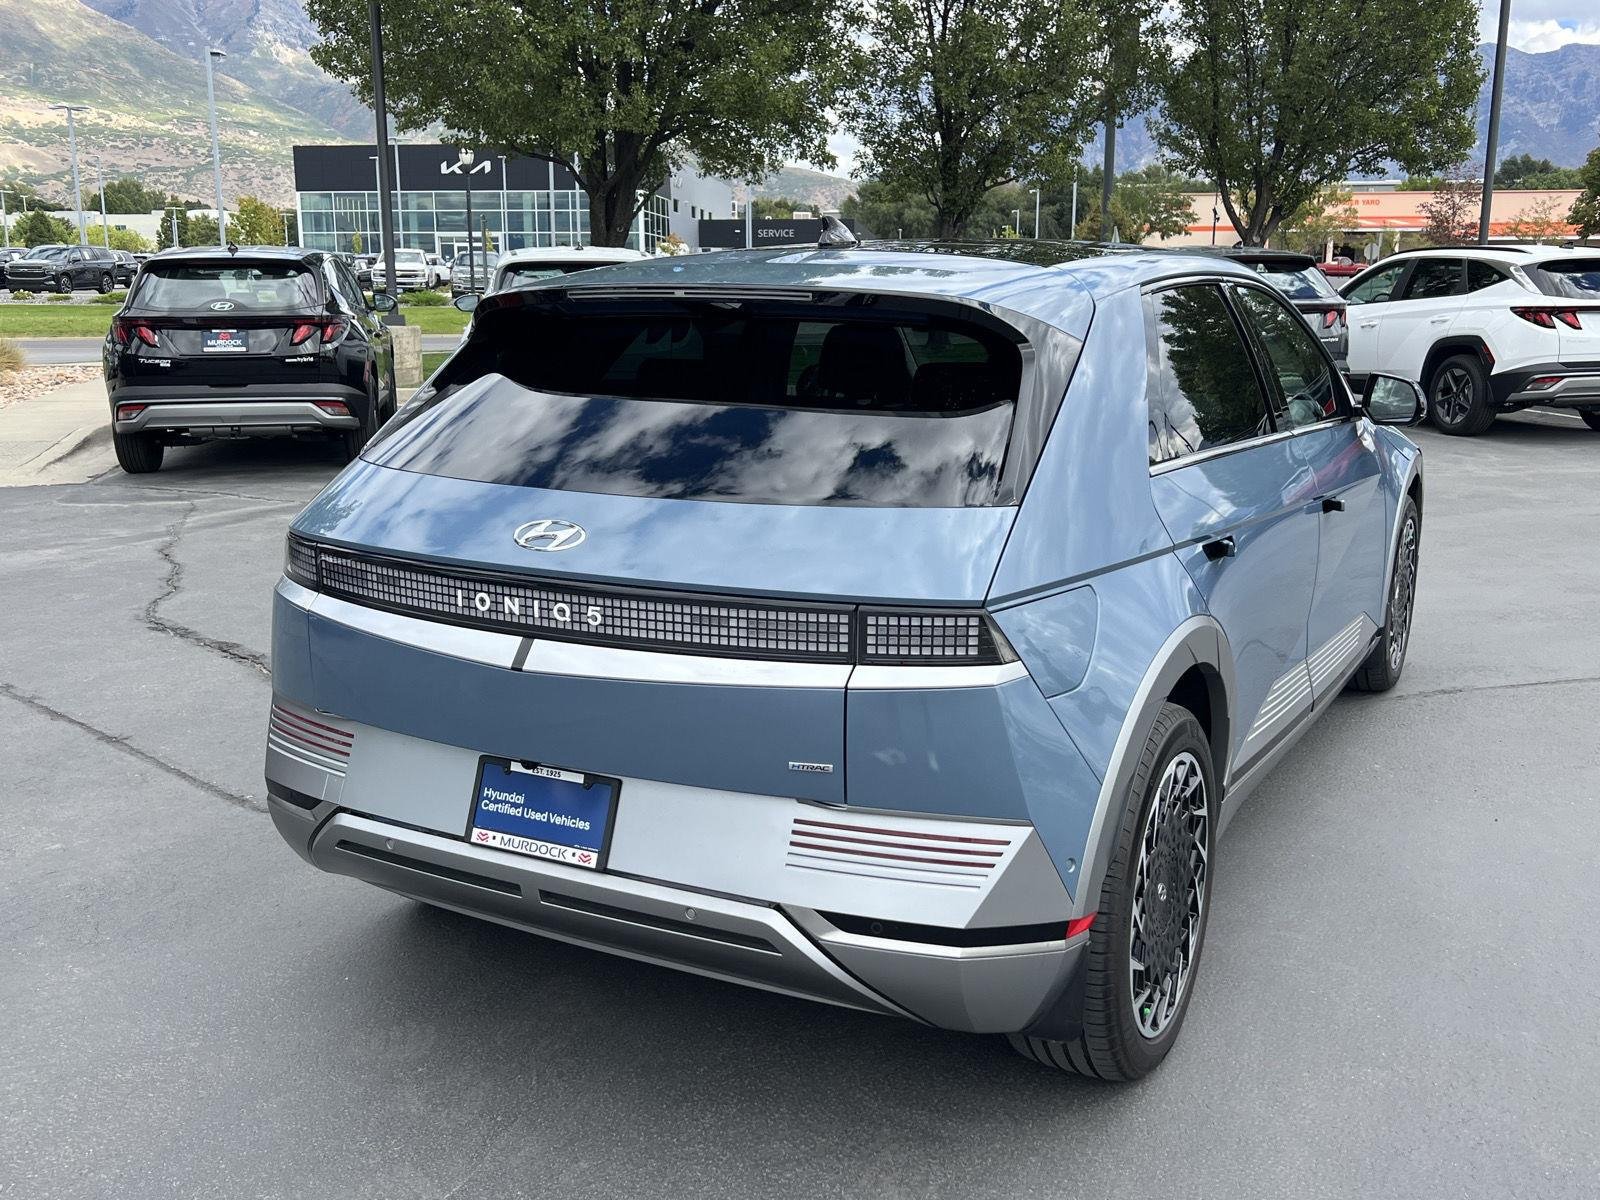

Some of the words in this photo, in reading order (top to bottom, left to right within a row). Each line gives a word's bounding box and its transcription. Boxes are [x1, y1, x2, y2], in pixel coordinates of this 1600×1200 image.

[440, 160, 492, 174] KA
[757, 228, 795, 238] SERVICE
[545, 769, 562, 778] 1925
[791, 763, 831, 772] HTRAC
[483, 787, 525, 804] Hyundai
[481, 800, 523, 817] Certified
[523, 808, 548, 823] Used
[549, 813, 591, 831] Vehicles
[499, 835, 568, 860] MURDOCK
